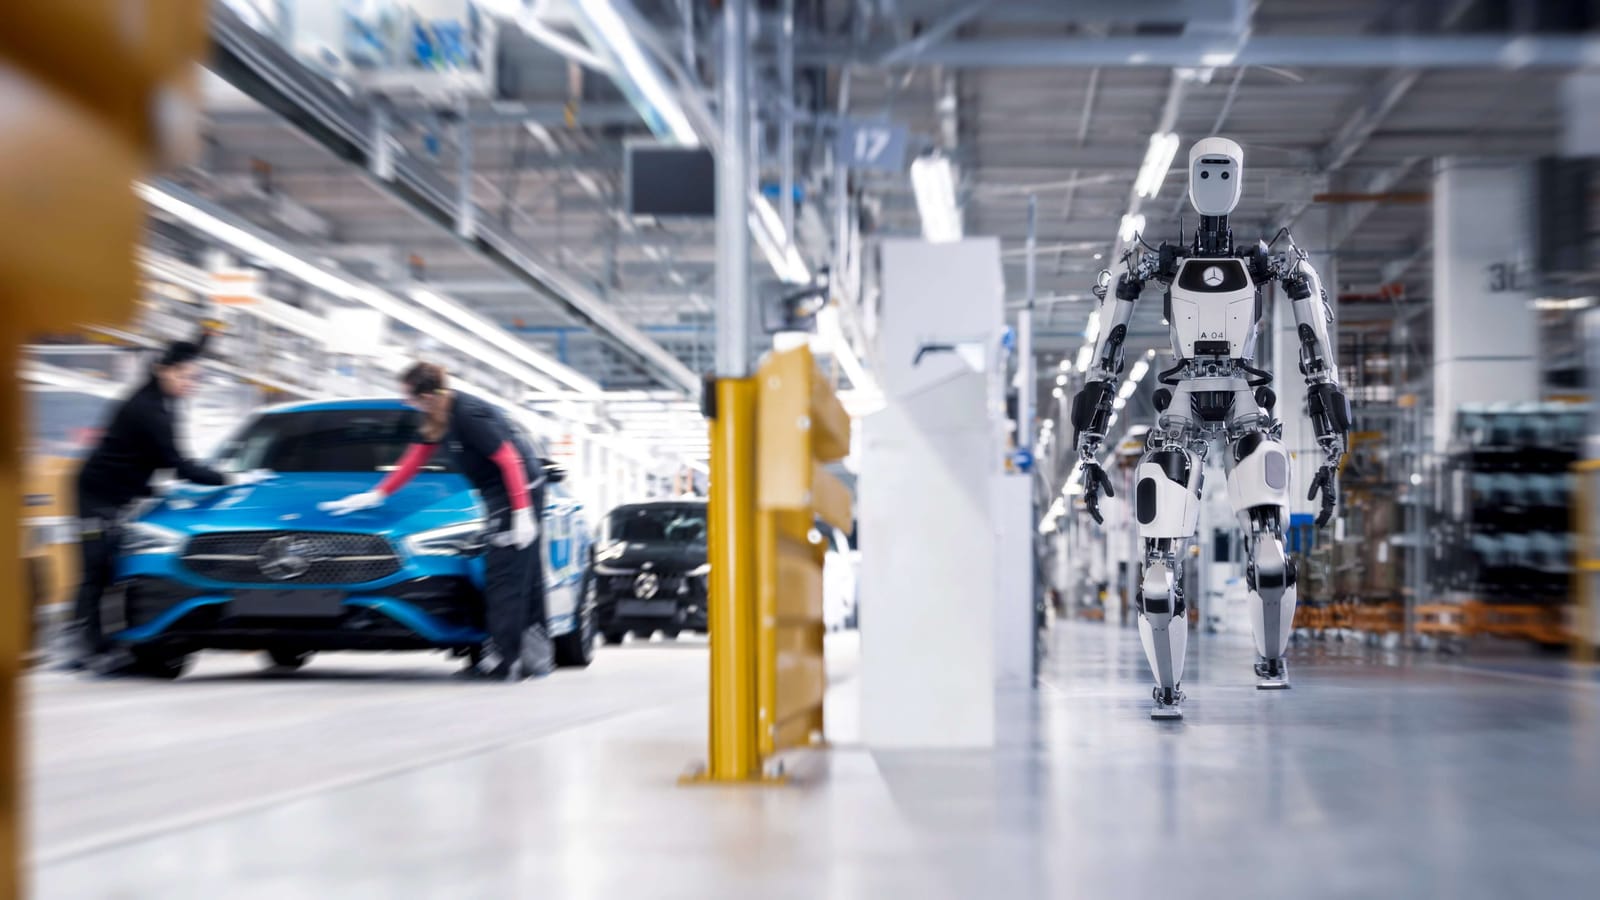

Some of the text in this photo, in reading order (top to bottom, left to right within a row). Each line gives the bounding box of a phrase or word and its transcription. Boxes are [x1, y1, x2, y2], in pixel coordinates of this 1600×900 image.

[854, 128, 890, 161] 17
[1200, 331, 1224, 340] A 04
